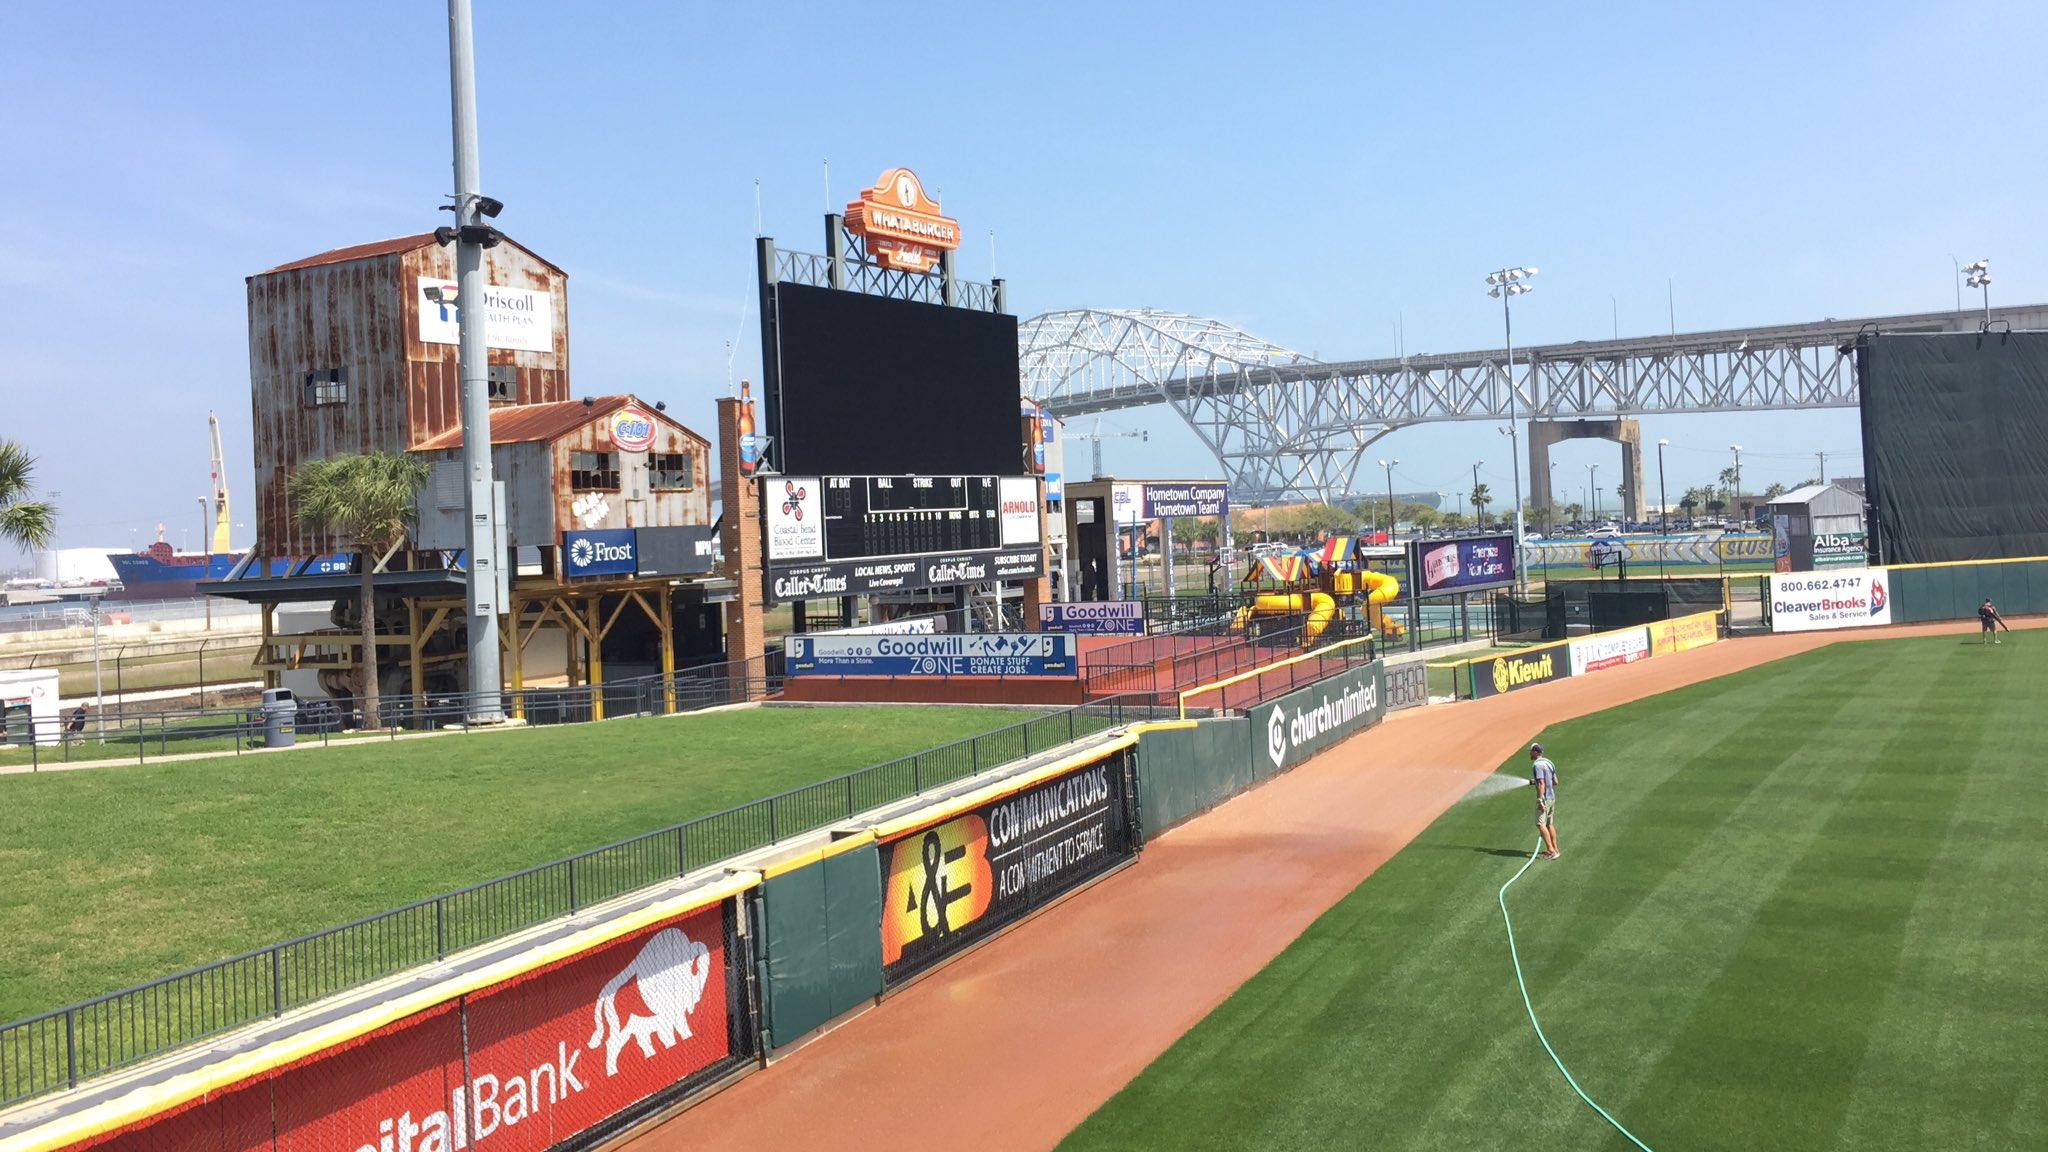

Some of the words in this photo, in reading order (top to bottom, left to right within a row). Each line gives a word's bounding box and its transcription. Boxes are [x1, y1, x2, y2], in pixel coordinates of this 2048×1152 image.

[871, 210, 954, 240] WHATABURGER
[512, 315, 535, 326] PLAN
[830, 477, 838, 489] AT
[839, 477, 851, 489] BAT
[878, 477, 893, 489] BALL
[913, 477, 933, 488] STRIKE
[950, 477, 962, 488] OUT
[1147, 487, 1189, 502] Hometown
[1190, 486, 1225, 503] Company
[1003, 501, 1036, 514] ARNOLD
[1154, 502, 1196, 517] Hometown
[1197, 501, 1220, 514] Team!
[773, 524, 798, 534] Coastal
[800, 523, 817, 534] Bend
[774, 536, 793, 546] Blood
[795, 535, 817, 545] Center
[1814, 534, 1850, 547] Alba
[595, 542, 632, 562] Frost
[694, 540, 712, 556] MPH
[1472, 544, 1499, 560] Energize
[1813, 545, 1841, 554] Insurance
[1841, 544, 1864, 554] Agency
[994, 555, 1020, 566] SUBSCRIBE
[1020, 553, 1038, 564] TODAY!
[1814, 553, 1864, 563] albainsurance.com
[789, 568, 810, 576] CORPUS
[855, 566, 875, 577] LOCAL
[875, 564, 893, 576] NEWS,
[893, 563, 916, 573] SPORTS
[1467, 562, 1482, 577] Your
[869, 579, 880, 588] Live
[1780, 578, 1862, 592] 800.662.4747
[1066, 603, 1134, 619] Goodwill
[1774, 597, 1867, 613] CleaverBrooks
[1809, 613, 1830, 621] Sales
[1839, 610, 1868, 619] Service
[1096, 619, 1135, 631] ZONE
[877, 637, 963, 656] Goodwill
[910, 657, 964, 674] ZONE
[970, 657, 1005, 667] DONATE
[1006, 656, 1032, 666] STUFF.
[970, 666, 1003, 674] CREATE
[1003, 665, 1029, 674] JOBS.
[1508, 653, 1553, 685] Kiewit
[1290, 676, 1377, 747] churchunlimited
[990, 765, 1108, 847] COMMUNICATIONS
[999, 869, 1007, 900] A
[1064, 837, 1075, 865] TO
[1075, 823, 1104, 861] SERVICE
